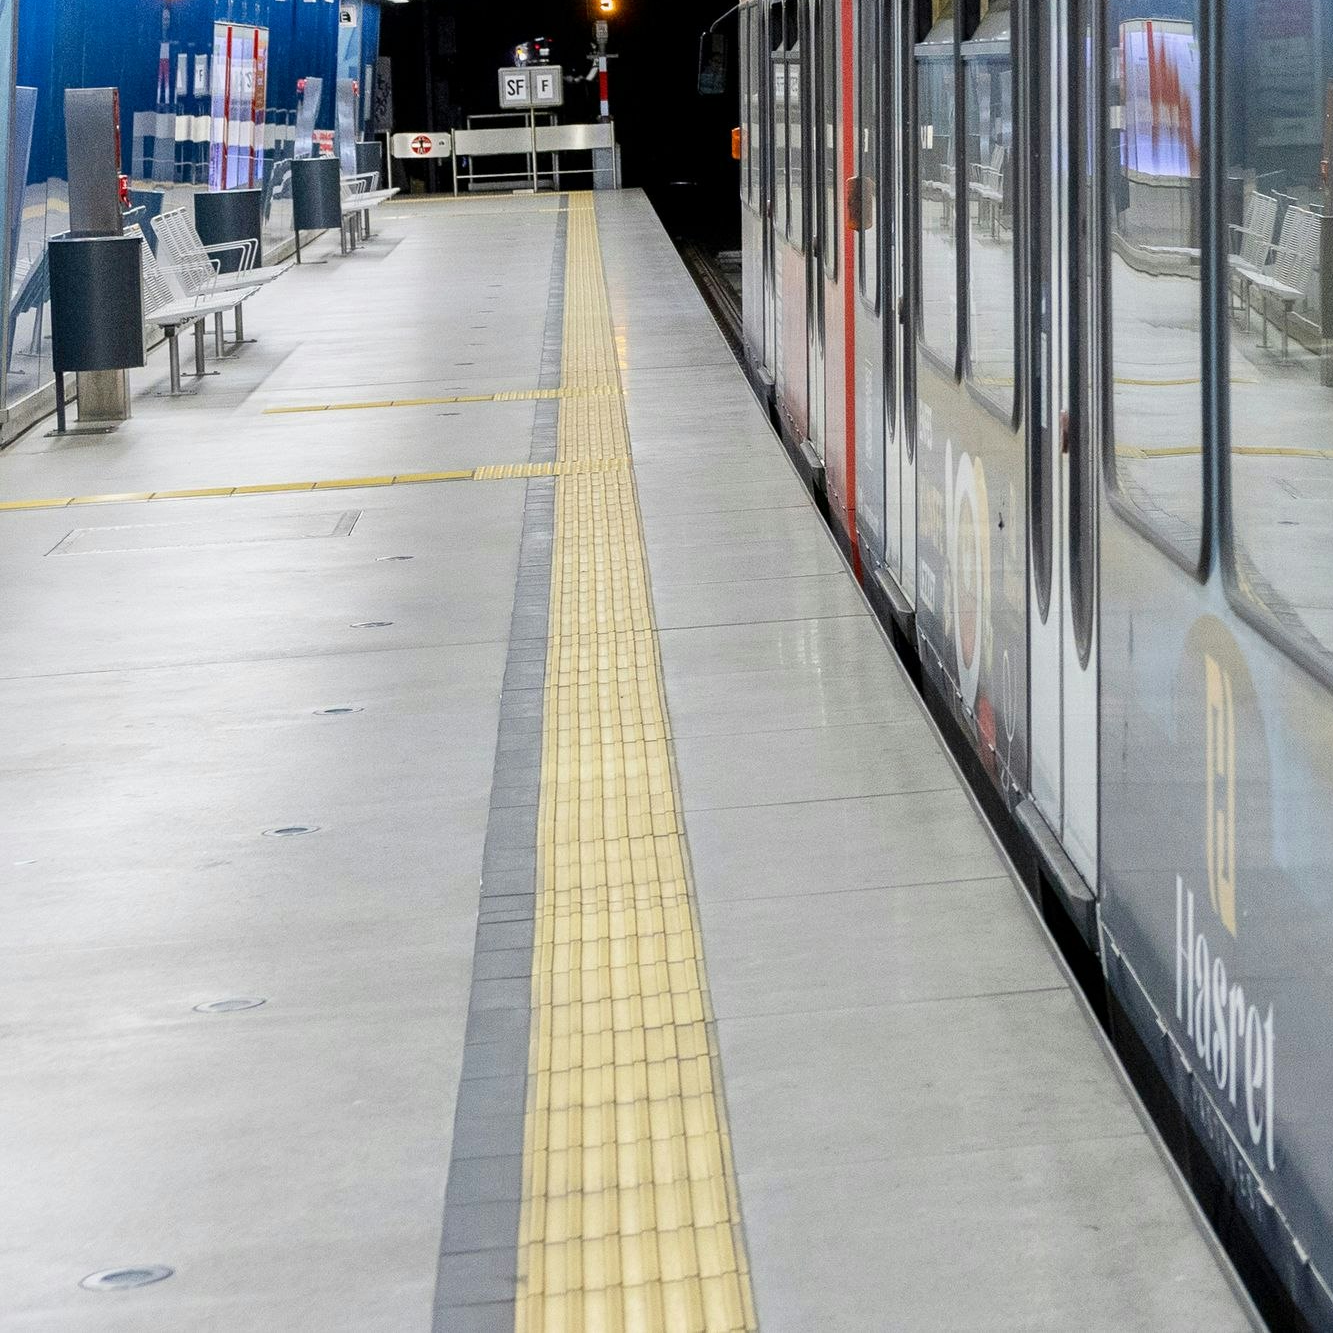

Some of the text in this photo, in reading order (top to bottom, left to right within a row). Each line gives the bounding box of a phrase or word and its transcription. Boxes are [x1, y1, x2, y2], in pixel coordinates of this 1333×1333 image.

[507, 78, 524, 96] SF
[542, 79, 548, 93] F
[1176, 873, 1275, 1172] Hasret
